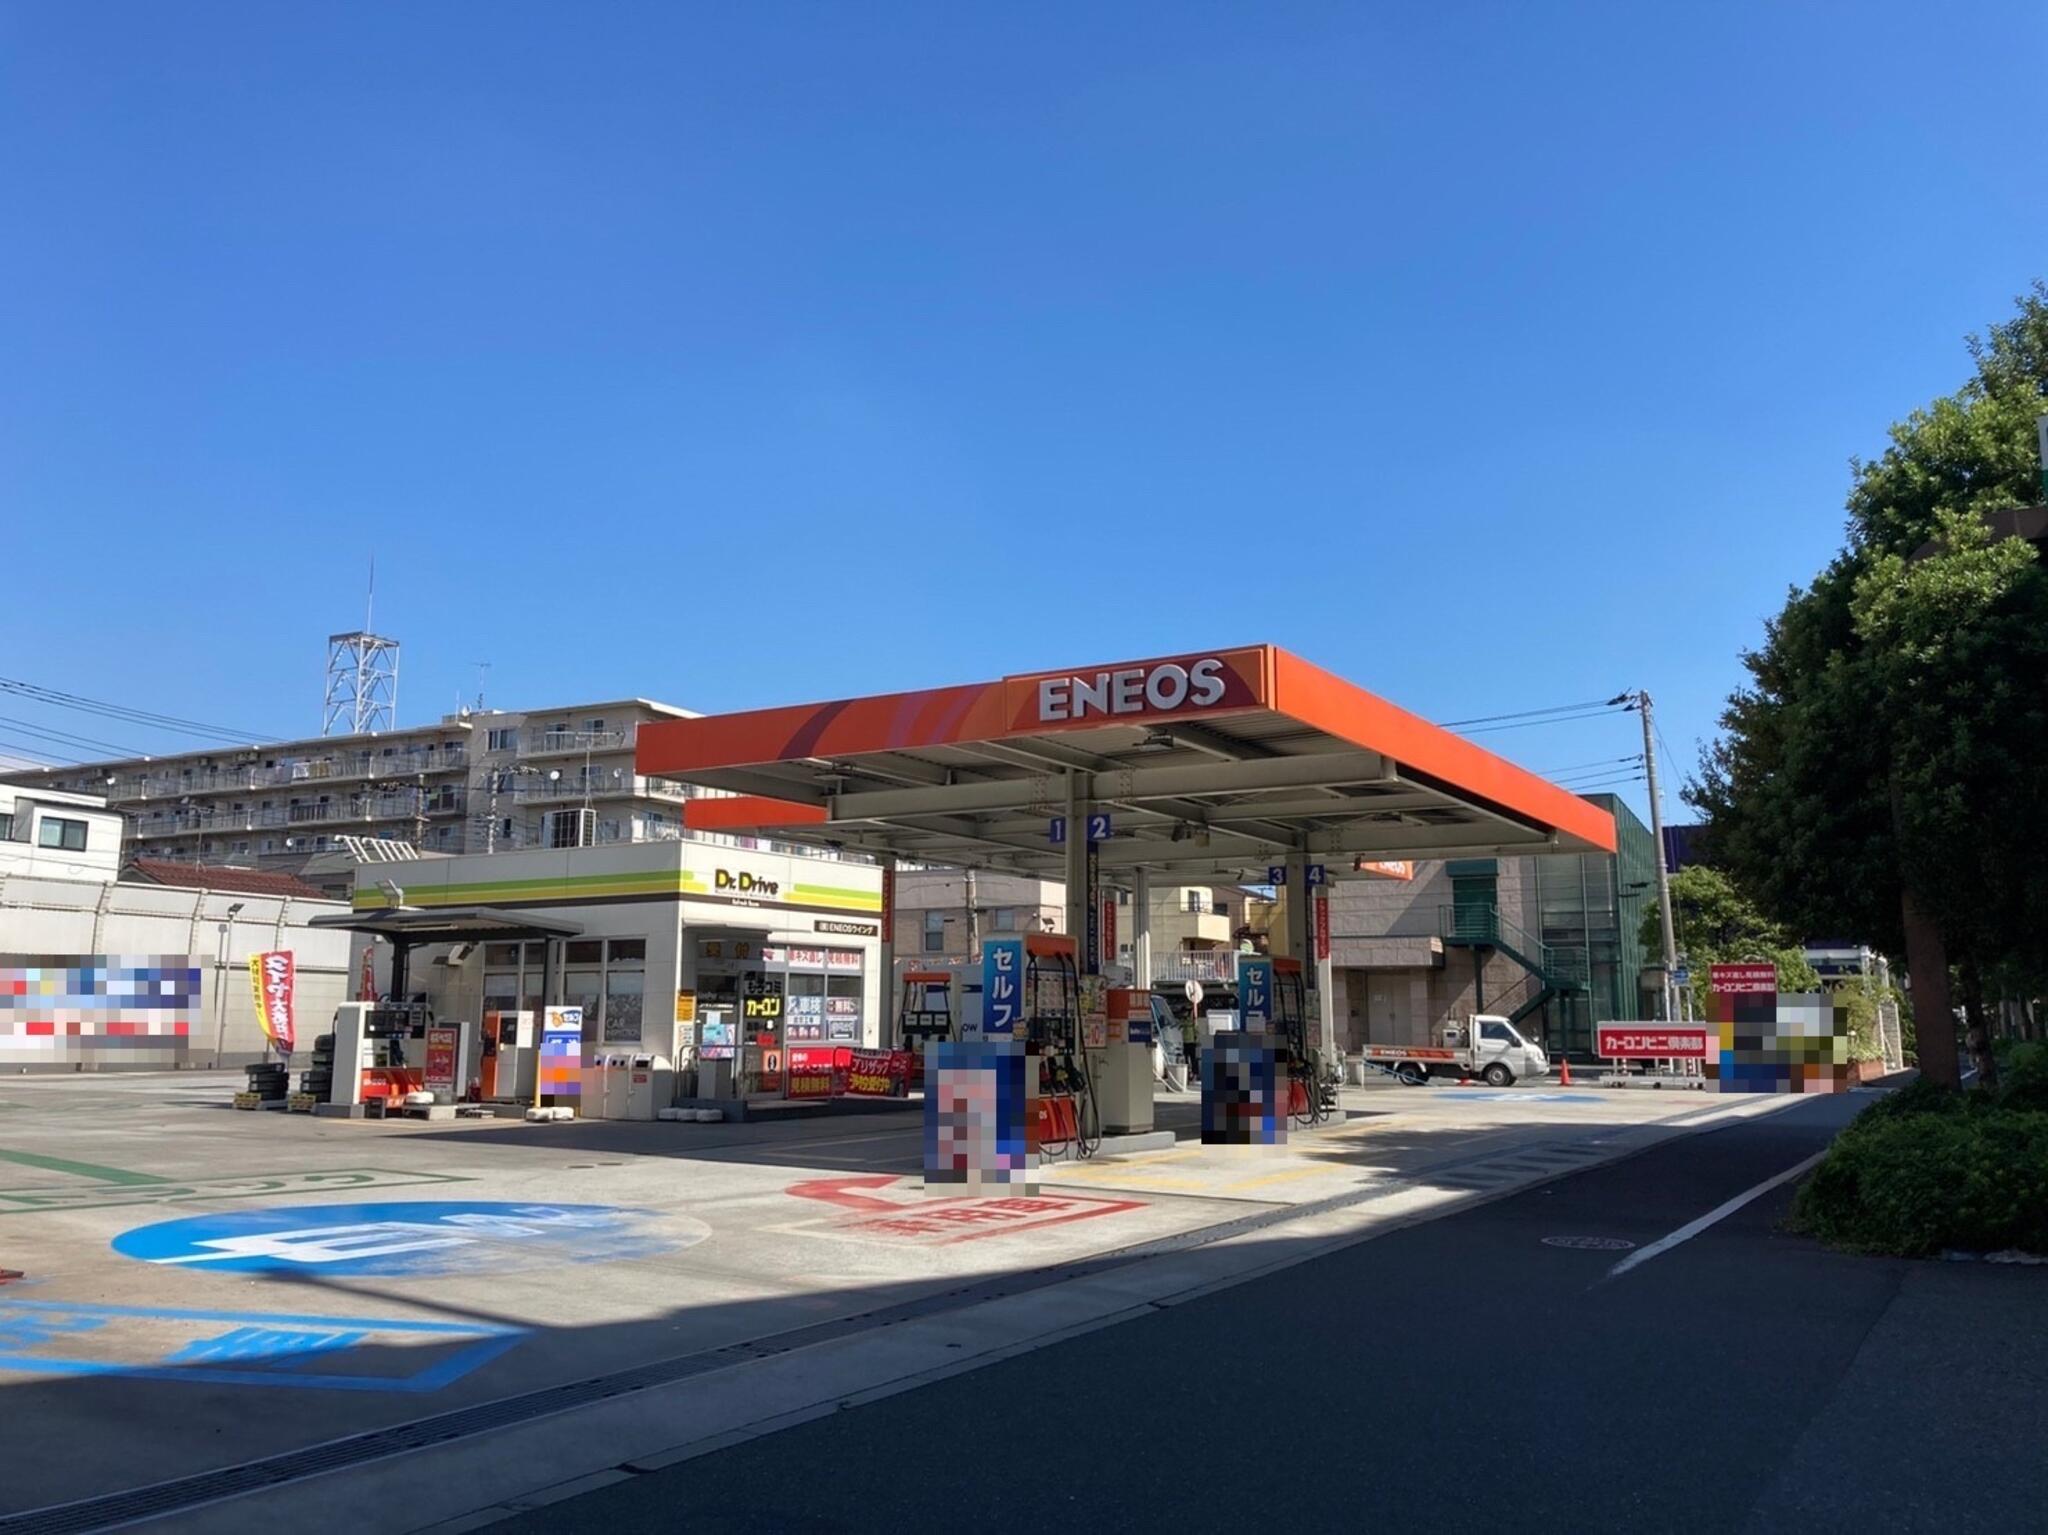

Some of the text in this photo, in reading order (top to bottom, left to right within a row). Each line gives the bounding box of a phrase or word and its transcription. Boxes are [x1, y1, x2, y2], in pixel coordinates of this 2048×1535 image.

[1039, 658, 1226, 722] ENEOS
[1055, 820, 1061, 841] 1
[1092, 817, 1106, 838] 2
[715, 868, 736, 890] Dr.
[738, 872, 779, 895] Drive
[1272, 868, 1283, 884] 3
[1309, 867, 1321, 883] 4
[993, 947, 1014, 1028] セルフ
[962, 1023, 978, 1033] OW
